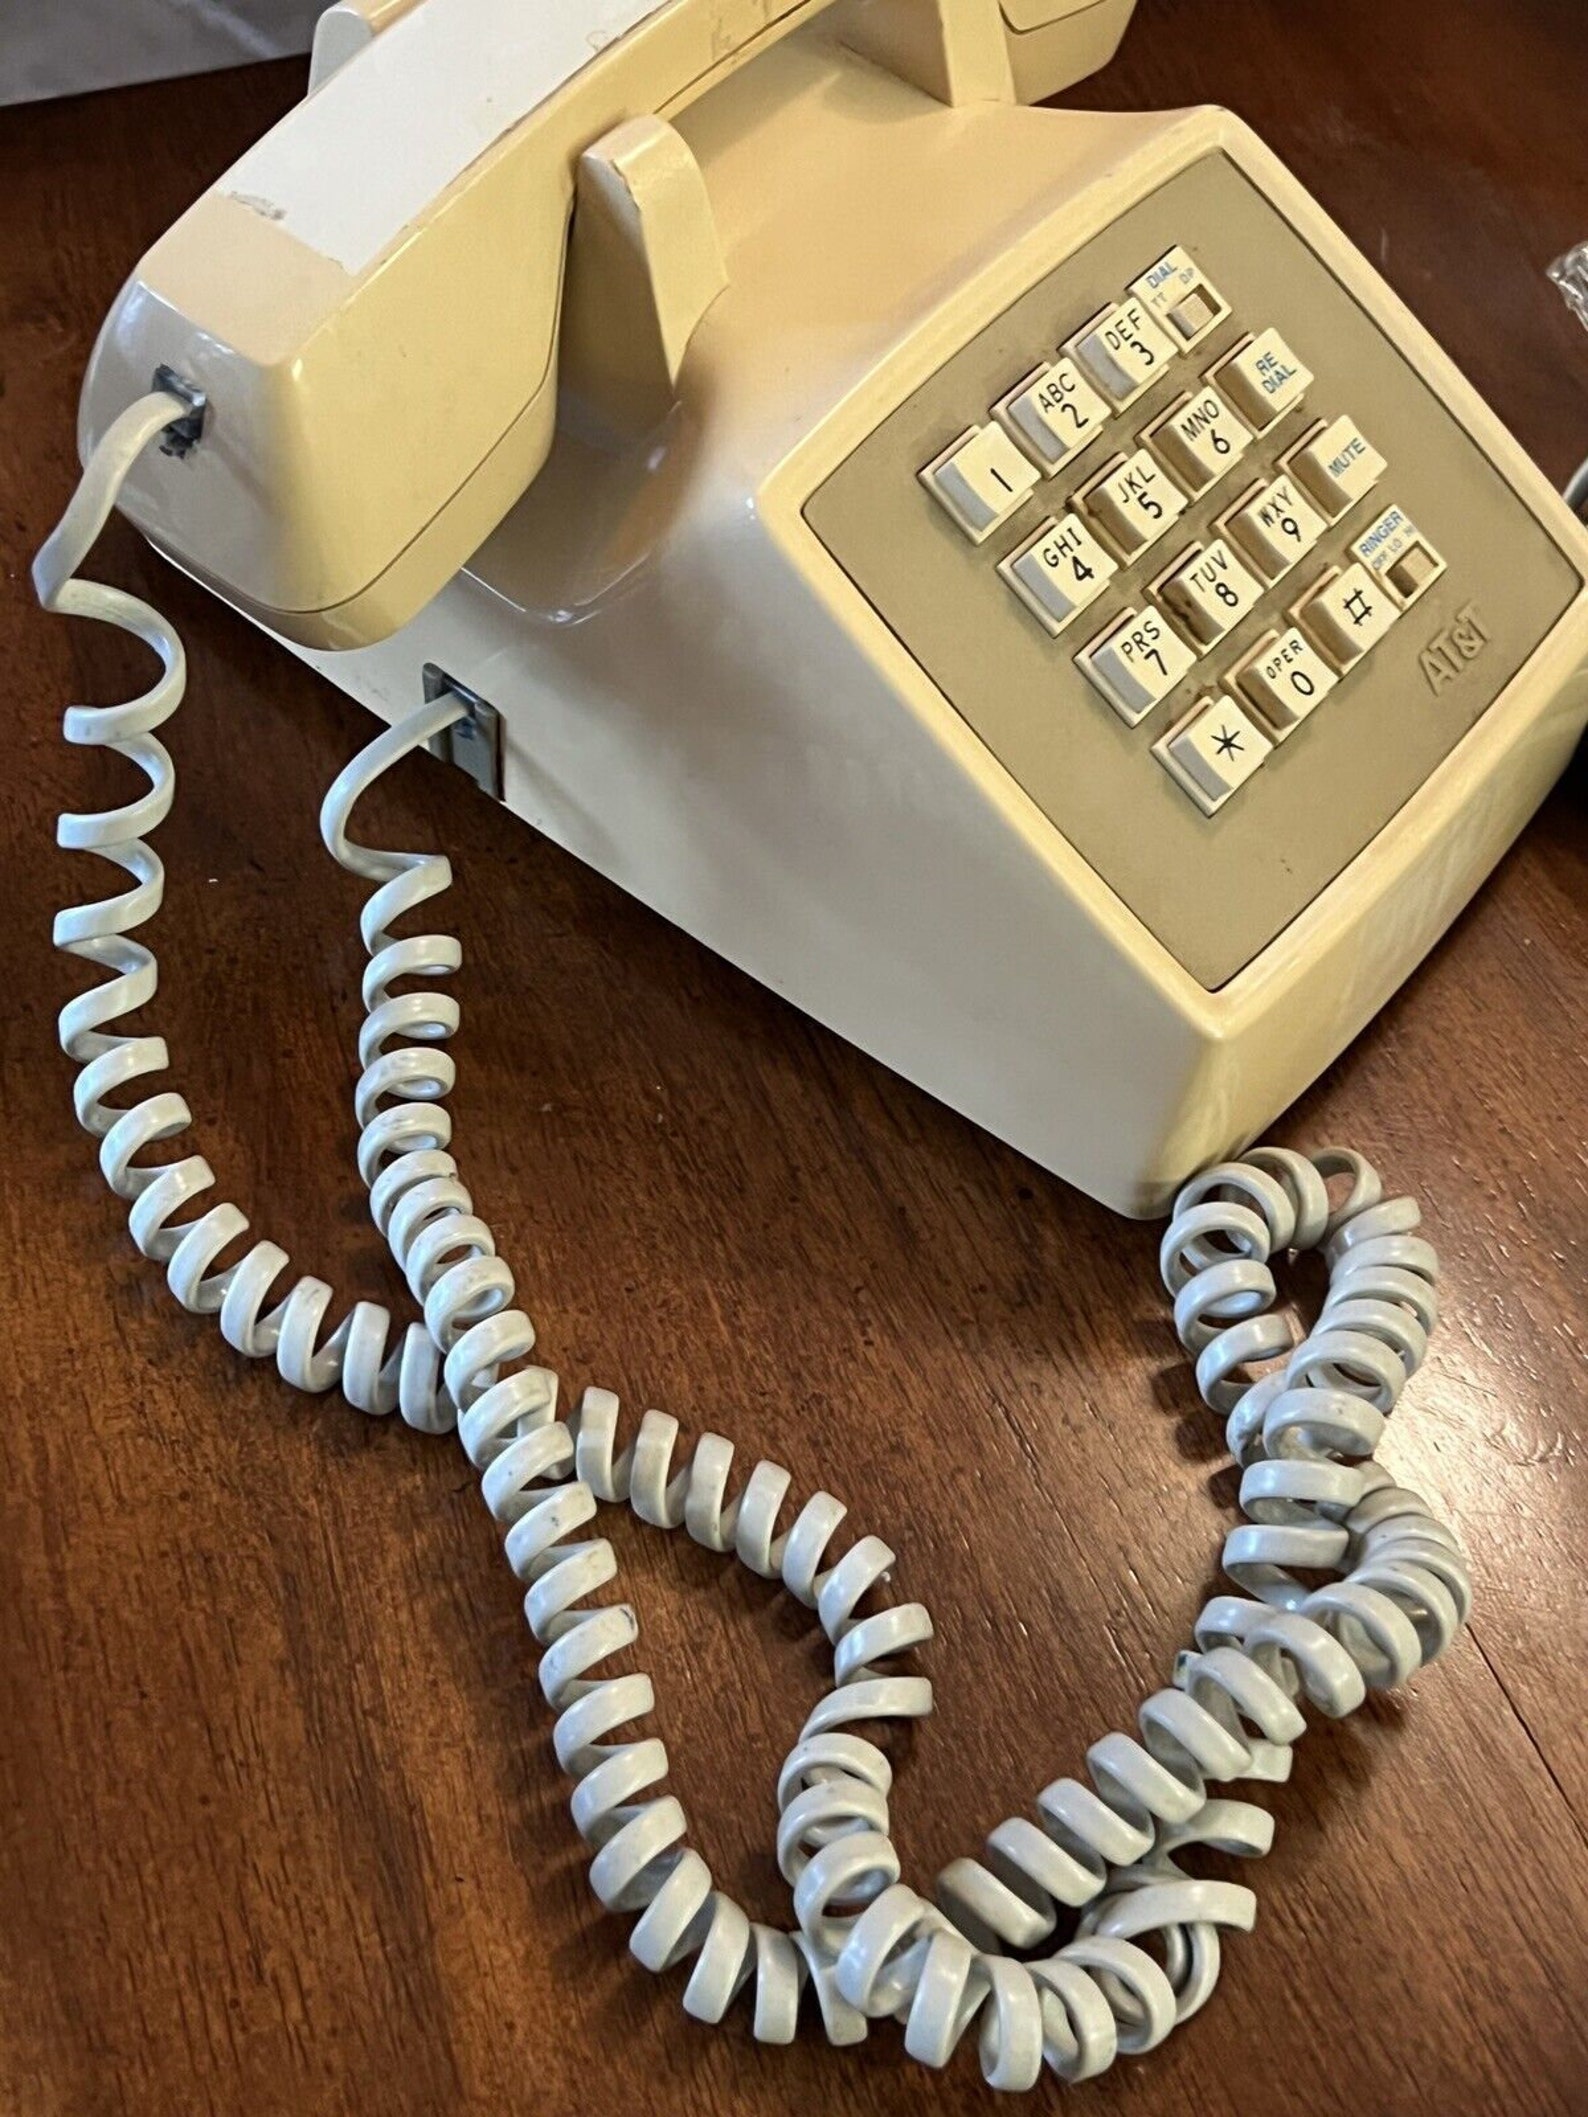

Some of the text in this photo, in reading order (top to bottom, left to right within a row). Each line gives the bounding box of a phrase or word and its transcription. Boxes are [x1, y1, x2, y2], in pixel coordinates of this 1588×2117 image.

[1146, 262, 1178, 289] DIAL
[1105, 308, 1141, 351] DEF
[1130, 341, 1154, 366] 3
[1256, 351, 1279, 376] RE
[1037, 372, 1076, 414] ABC
[1262, 364, 1297, 394] DIAL
[1061, 404, 1089, 429] 2
[1181, 399, 1220, 442] MNO
[1210, 429, 1231, 454] 6
[1327, 437, 1367, 479] MUTE
[1117, 466, 1156, 504] JKL
[1138, 492, 1163, 520] 5
[1257, 486, 1293, 528] WXY
[1042, 527, 1083, 568] GHI
[1281, 517, 1302, 543] 9
[1359, 511, 1404, 558] RINGER
[1070, 556, 1096, 582] 4
[1189, 550, 1228, 593] TUV
[1215, 582, 1239, 607] 8
[1120, 620, 1161, 664] PRS
[1265, 639, 1304, 680] OPER
[1418, 599, 1489, 697] AT&T
[1143, 648, 1168, 676] 7
